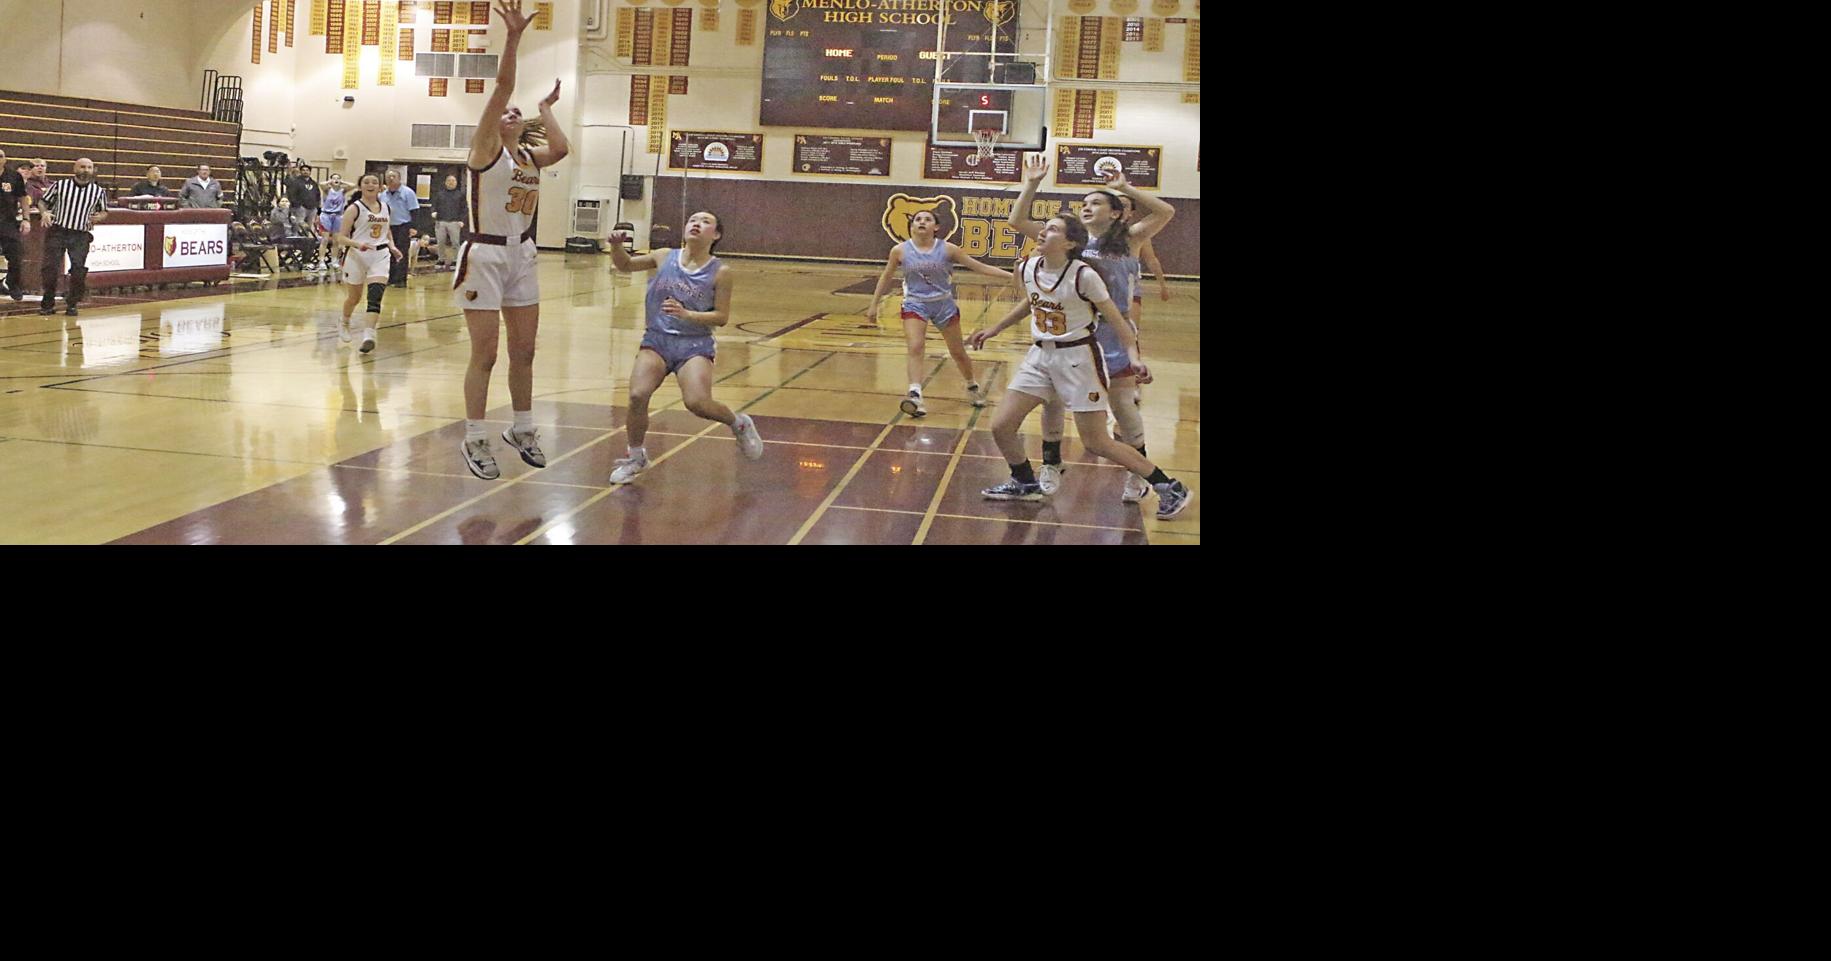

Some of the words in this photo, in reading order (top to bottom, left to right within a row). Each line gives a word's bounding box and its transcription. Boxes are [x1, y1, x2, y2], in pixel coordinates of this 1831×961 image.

[823, 11, 873, 23] HIGH
[825, 48, 854, 58] HOME
[918, 51, 951, 60] GUET
[980, 95, 989, 105] S
[511, 168, 540, 185] Bear
[1031, 200, 1062, 220] OF
[367, 214, 389, 223] Bears
[370, 223, 383, 239] 3
[180, 240, 224, 256] BEARS
[1030, 292, 1065, 310] Bears
[1033, 307, 1067, 336] 33
